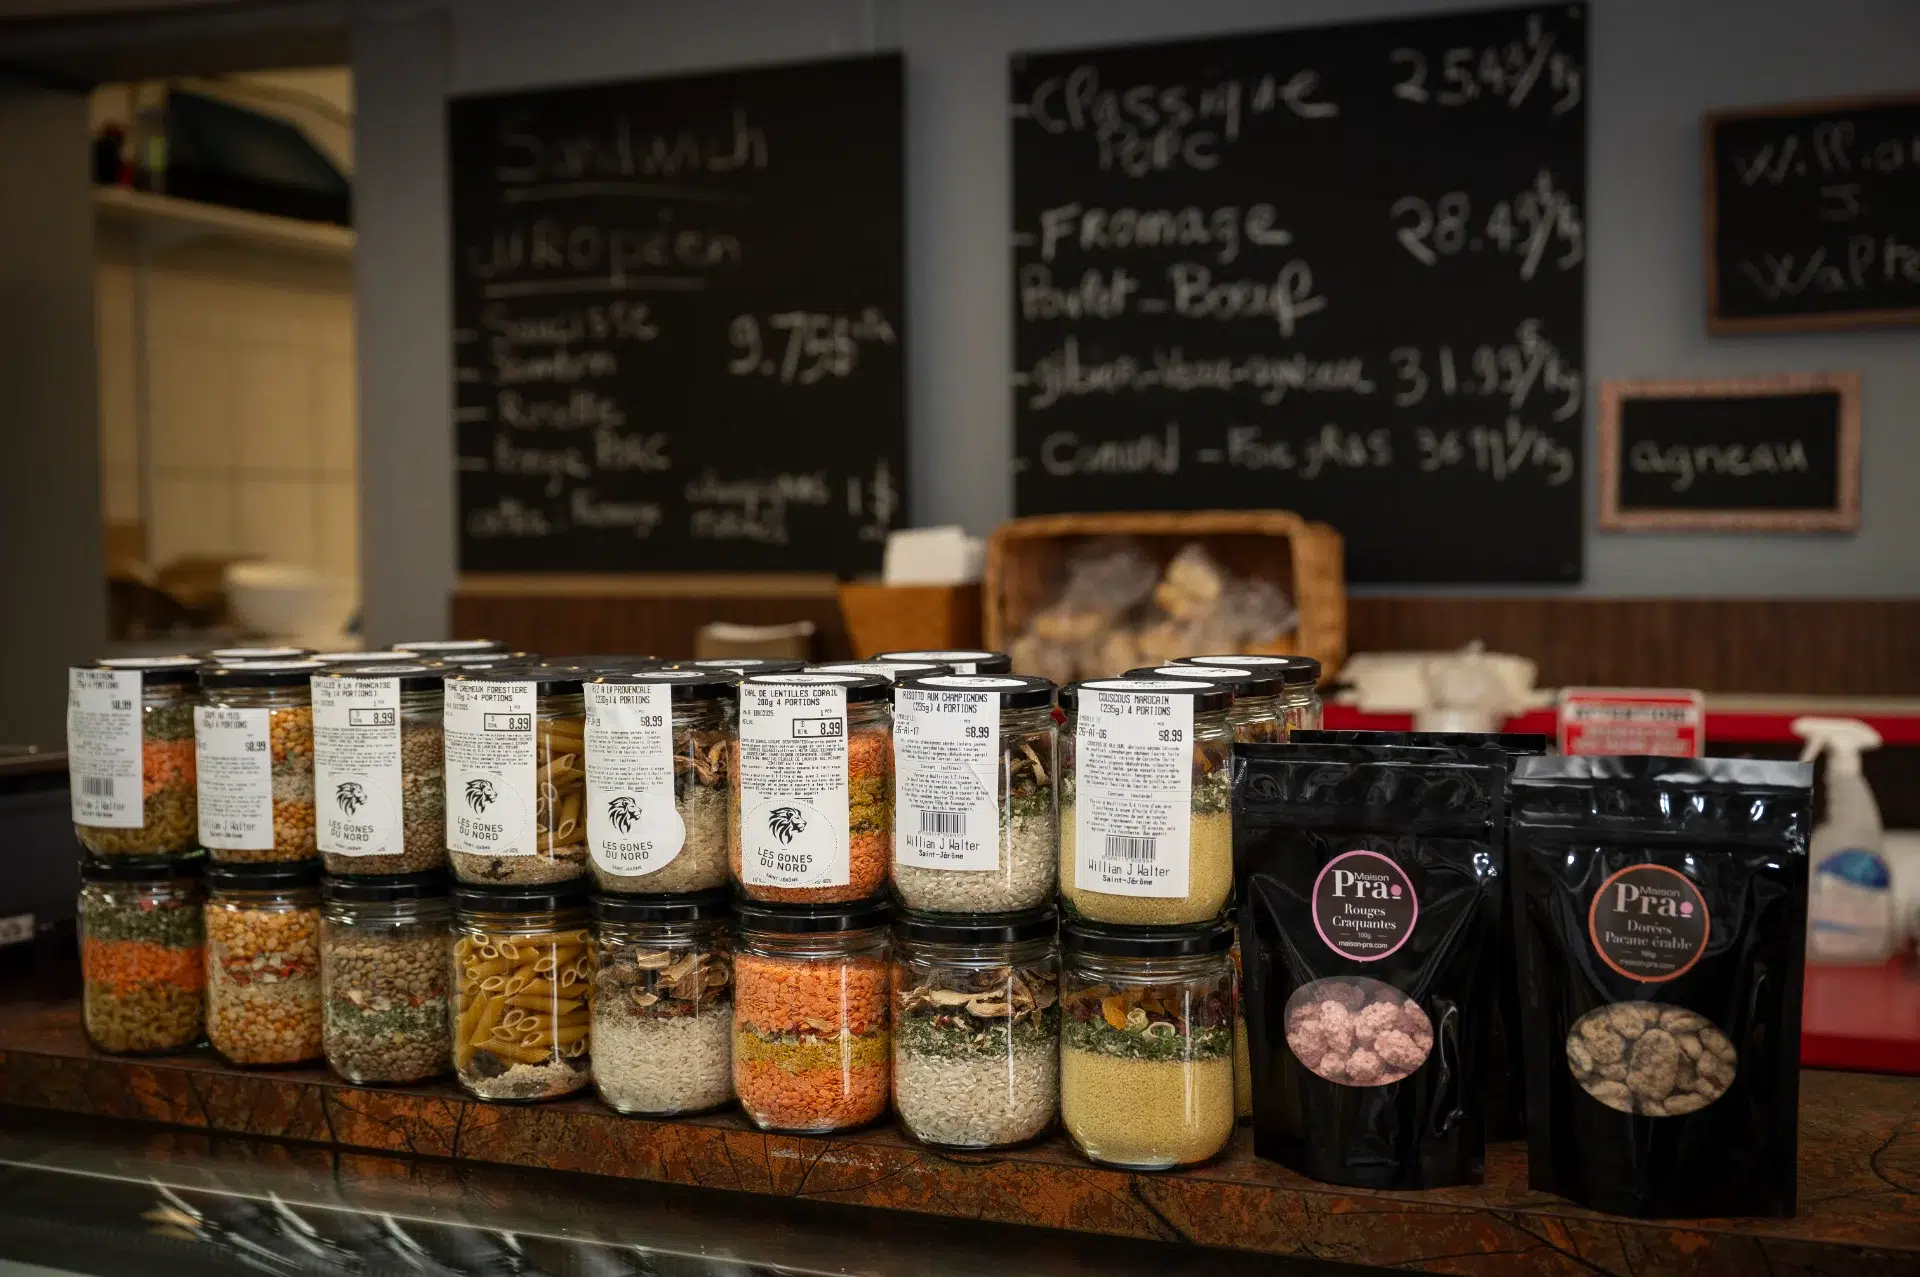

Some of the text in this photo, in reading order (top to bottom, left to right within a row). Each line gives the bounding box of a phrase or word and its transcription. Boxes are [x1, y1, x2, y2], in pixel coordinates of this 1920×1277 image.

[1630, 439, 1809, 491] agneau
[344, 682, 352, 690] LA
[481, 694, 513, 702] PORTIONS
[759, 689, 767, 697] DE
[770, 689, 809, 697] LENTILLES
[813, 688, 838, 697] CORAIL
[927, 692, 939, 702] AUX
[942, 693, 988, 702] CHAMPIGNONS
[1098, 692, 1169, 705] COUSCOUS MAROCAIN
[620, 696, 650, 705] PORTIONS
[785, 698, 820, 706] PORTIONS
[943, 703, 977, 713] PORTIONS
[1127, 706, 1132, 715] 4
[1136, 706, 1171, 716] PORTIONS
[373, 712, 393, 724] 8.99
[509, 717, 528, 730] 8.99
[641, 715, 662, 727] $8.99
[820, 722, 841, 735] 8.99
[965, 727, 989, 739] $8.99
[1159, 730, 1182, 742] $8.99
[328, 818, 374, 833] LES GONES
[457, 815, 503, 833] LES GONES
[331, 829, 369, 841] DU NORD
[459, 826, 498, 841] DU NORD
[602, 840, 653, 852] LES GONES
[940, 838, 945, 849] J
[949, 839, 981, 851] Walter
[606, 850, 649, 861] DU NORD
[757, 847, 813, 863] LES GONES
[760, 857, 808, 873] DU NORD
[1127, 864, 1133, 876] J
[1138, 864, 1170, 877] Walter
[1354, 872, 1390, 884] Maison
[1639, 885, 1681, 900] Maison
[1344, 903, 1386, 920] Rouges
[1332, 915, 1397, 933] Craquantes
[1627, 919, 1673, 935] Dorées
[1338, 942, 1388, 951] maison-pra.com
[1605, 930, 1693, 953] Pacane érable
